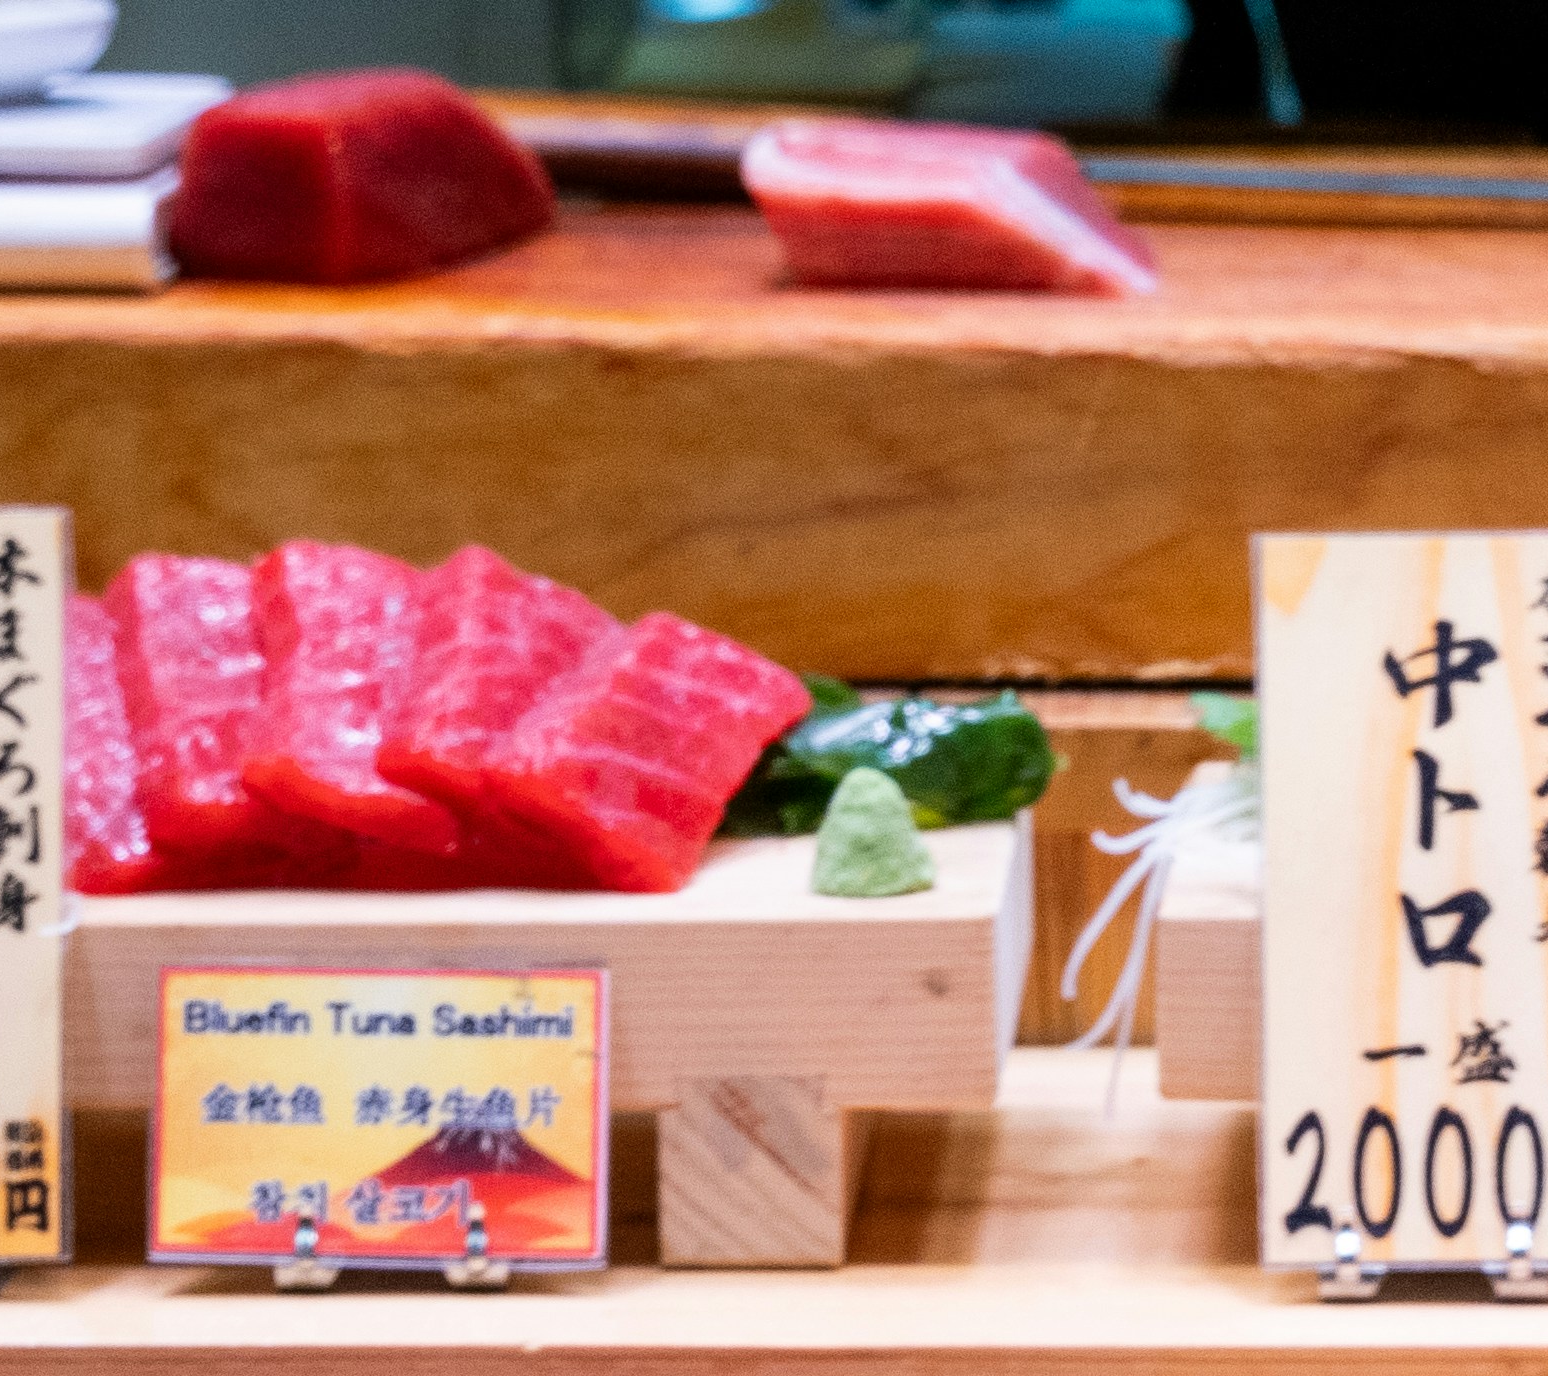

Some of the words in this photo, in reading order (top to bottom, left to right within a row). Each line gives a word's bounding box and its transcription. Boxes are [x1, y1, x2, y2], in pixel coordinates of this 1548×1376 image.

[1385, 621, 1497, 967] 中トロ
[184, 1000, 310, 1035] Bluefin
[326, 1002, 416, 1036] Tuna
[433, 1003, 573, 1037] Sashimi
[1364, 1023, 1514, 1083] 一盛
[1286, 1107, 1543, 1238] 2000
[7, 1179, 48, 1230] 円
